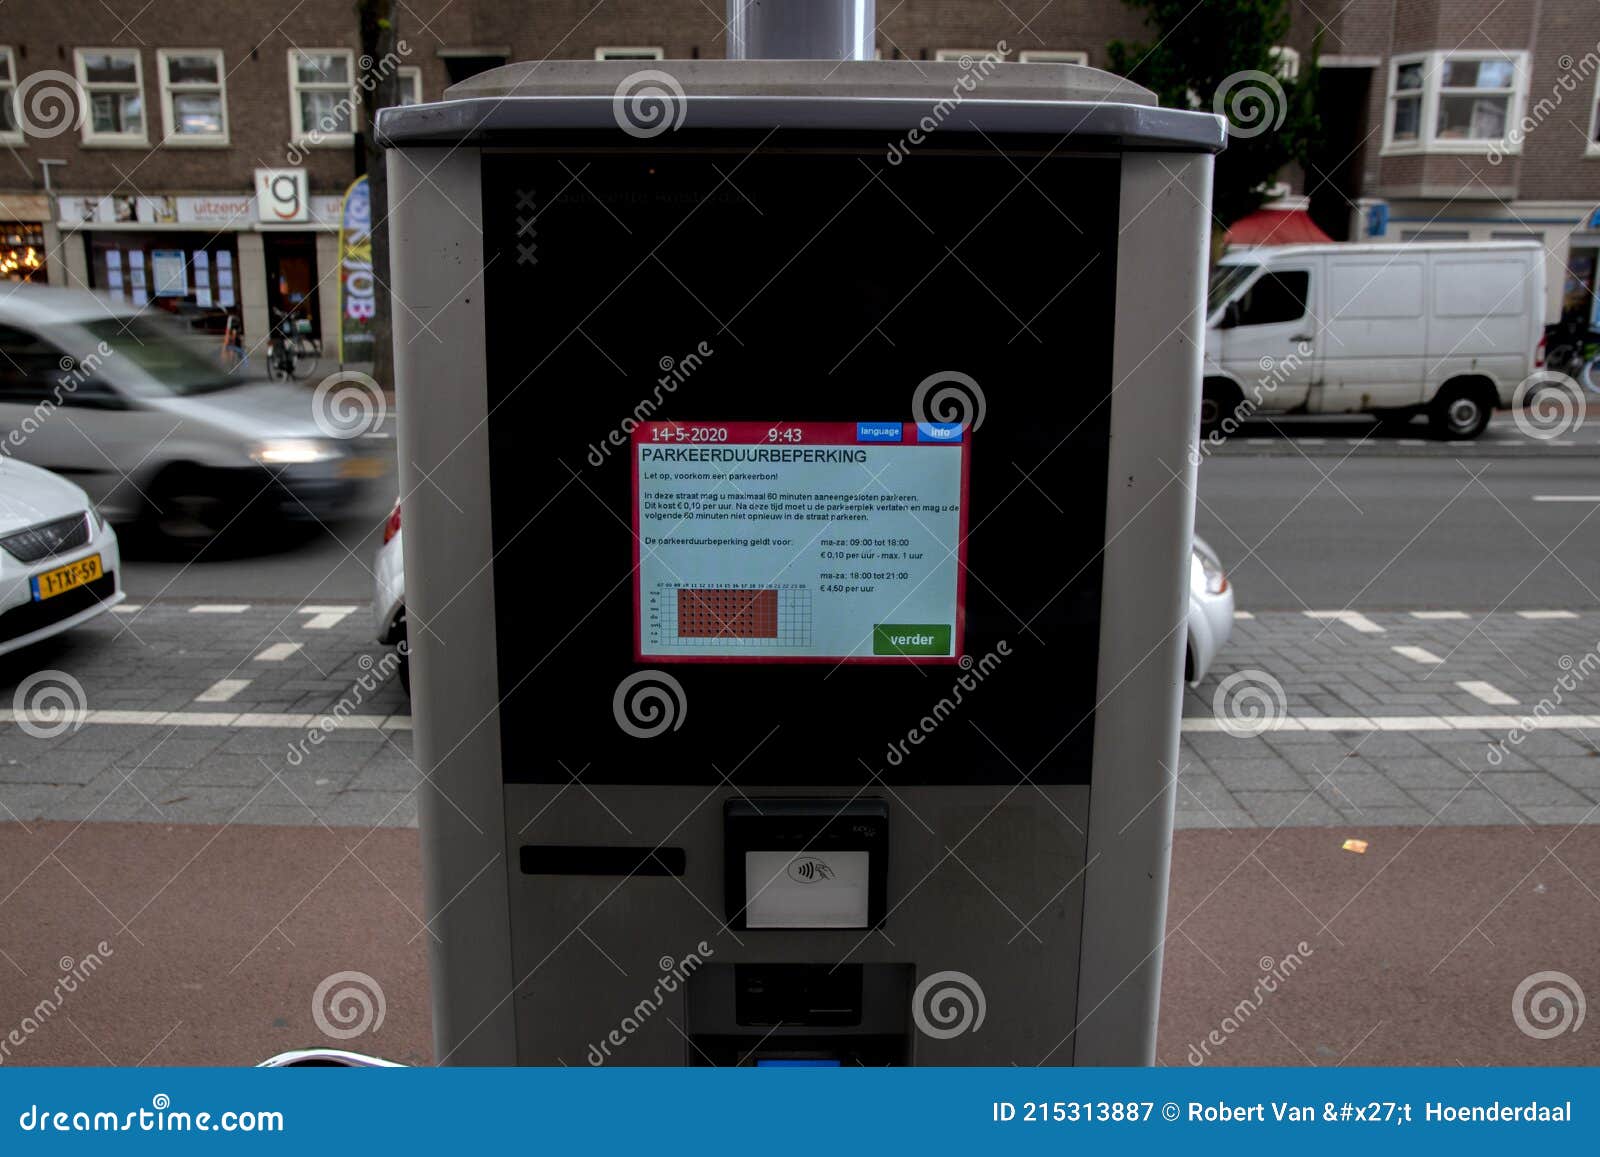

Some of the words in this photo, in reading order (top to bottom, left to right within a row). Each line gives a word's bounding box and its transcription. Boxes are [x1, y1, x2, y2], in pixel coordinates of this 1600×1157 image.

[194, 198, 249, 214] uitzend
[651, 427, 728, 442] 14-5-2020
[768, 428, 802, 442] 9:43
[861, 427, 900, 437] language
[642, 448, 867, 463] PARKEERDUURBEPERKING
[676, 492, 699, 500] straat
[701, 493, 718, 502] mag
[728, 492, 766, 500] maximaal
[814, 493, 879, 502] aaneengesloten
[644, 502, 656, 510] Dit
[658, 502, 676, 510] kost
[684, 502, 701, 511] 0,10
[703, 503, 716, 512] per
[770, 503, 783, 512] tijd
[785, 503, 805, 511] moet
[923, 505, 940, 513] mag
[644, 512, 684, 521] volgende
[696, 512, 729, 520] minuten
[748, 513, 783, 521] opnieuw
[806, 513, 829, 521] straat
[645, 537, 656, 545] De
[750, 537, 770, 547] geldt
[850, 538, 873, 547] 09:00
[874, 539, 886, 547] tot
[888, 538, 910, 547] 18:00
[846, 552, 859, 561] per
[861, 552, 875, 560] uur
[45, 560, 97, 593] 1-TXF-59
[873, 572, 885, 580] tot
[886, 572, 909, 580] 21:00
[845, 586, 859, 594] per
[890, 633, 935, 646] verder
